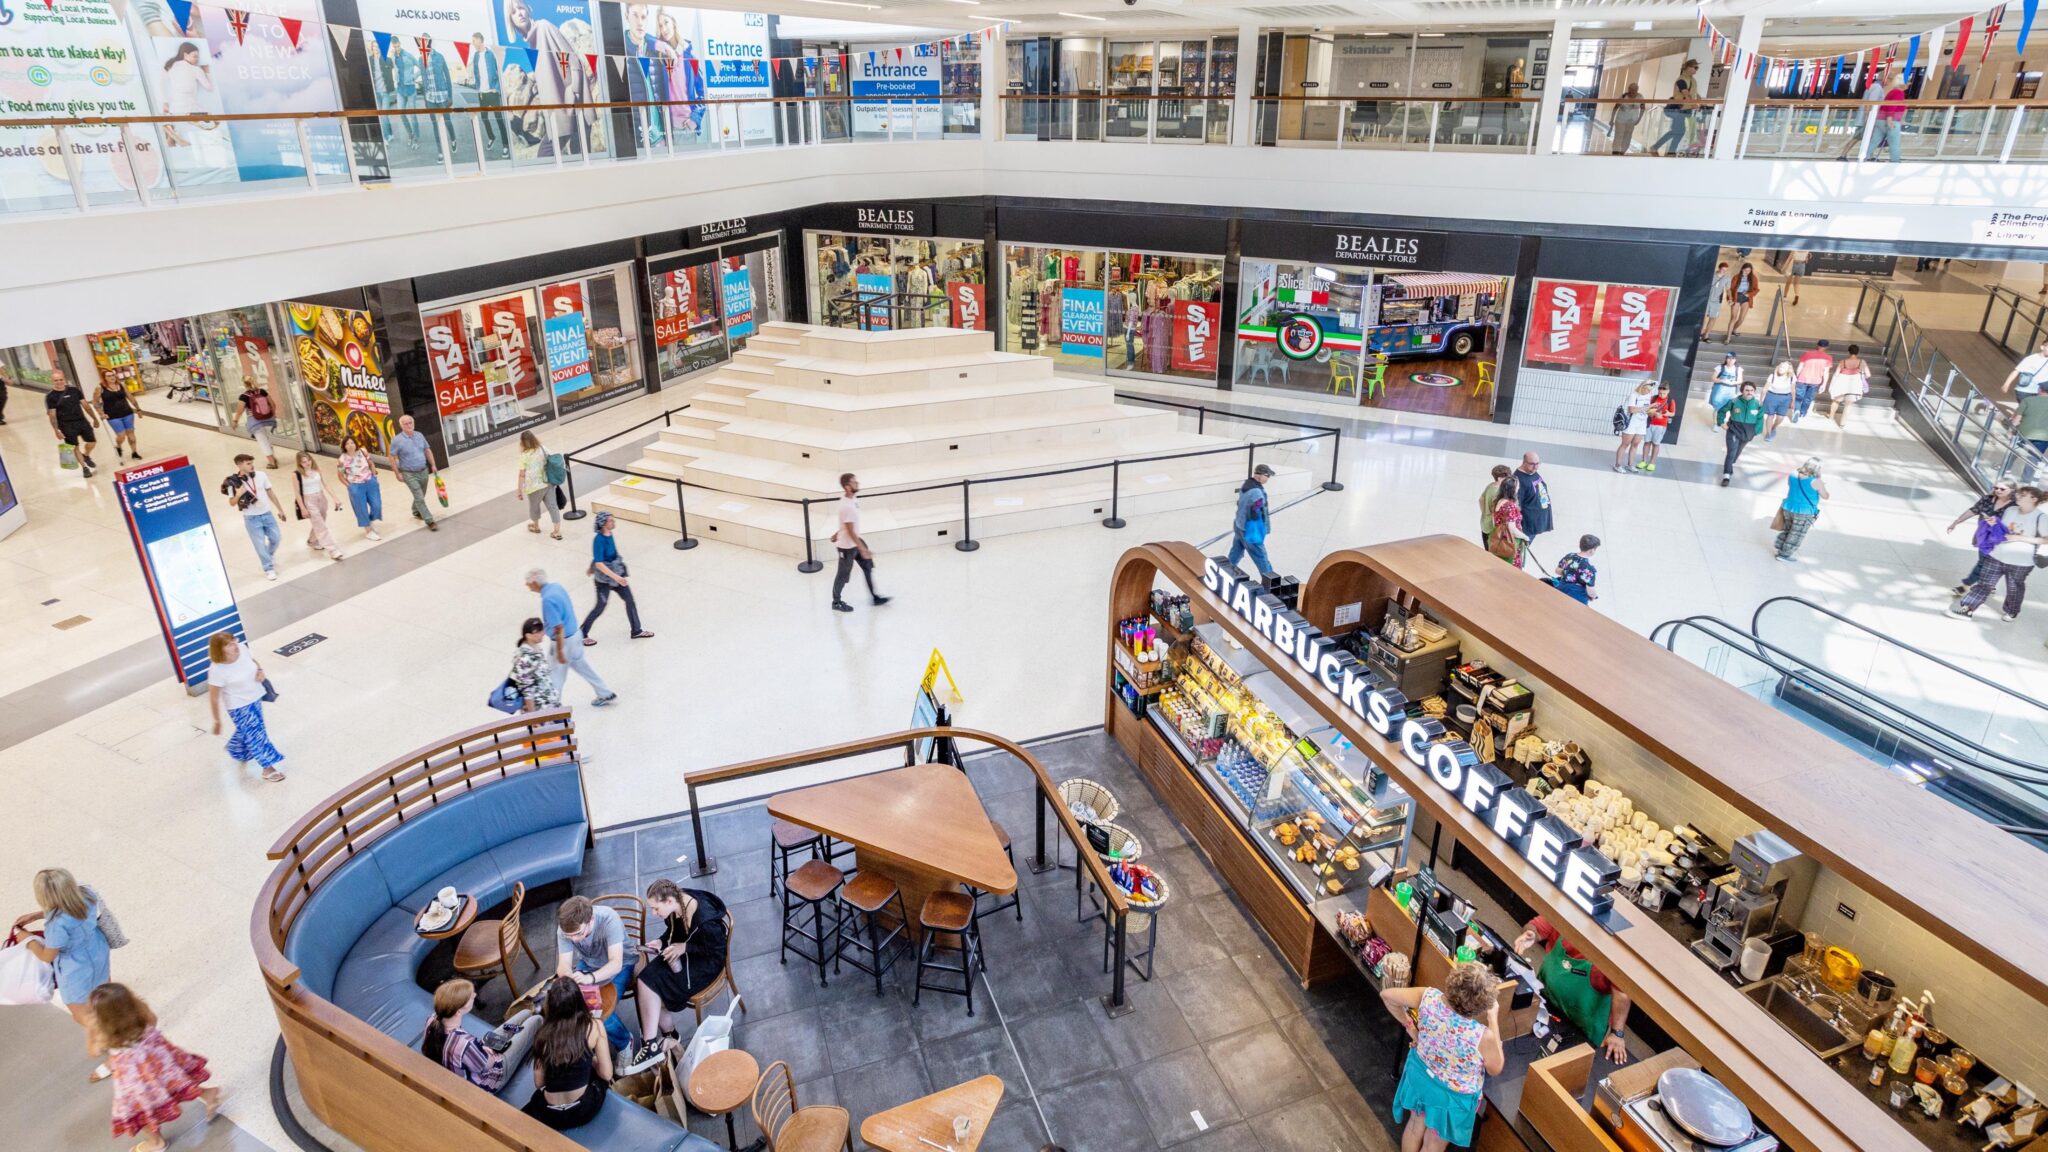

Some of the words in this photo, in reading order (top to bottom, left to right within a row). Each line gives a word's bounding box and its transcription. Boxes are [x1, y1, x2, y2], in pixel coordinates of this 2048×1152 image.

[556, 5, 584, 14] APRICOT
[11, 46, 24, 58] to
[27, 46, 44, 58] eat
[47, 46, 66, 59] the
[67, 45, 100, 59] Naked
[101, 46, 127, 63] Way!
[249, 44, 291, 59] NEW
[707, 39, 763, 57] Entrance
[238, 65, 312, 80] BEDECK
[864, 63, 928, 77] Entrance
[876, 82, 916, 90] Pre-booked
[35, 102, 65, 112] menu
[68, 99, 95, 115] gives
[98, 101, 117, 114] you
[119, 99, 136, 111] the
[71, 142, 93, 154] the
[857, 208, 914, 224] BEALES
[1755, 209, 1779, 217] Skills
[1789, 211, 1829, 220] Learning
[2002, 213, 2021, 221] The
[858, 222, 892, 230] DEPARTMENT
[894, 223, 914, 231] STORES
[1753, 219, 1775, 227] NHS
[701, 230, 731, 242] DEPARTMENT
[731, 227, 747, 236] STORES
[1336, 234, 1419, 255] BEALES
[1335, 250, 1386, 261] DEPARTMENT
[1387, 254, 1417, 264] STORES
[1062, 298, 1103, 314] FINAL
[741, 312, 751, 322] ON
[1062, 311, 1104, 322] CLEARANCE
[1550, 286, 1581, 353] SALE
[656, 318, 687, 340] SALE
[1062, 319, 1103, 333] EVENT
[1186, 303, 1210, 362] SALE
[1619, 291, 1651, 360] SALE
[545, 325, 585, 346] FINAL
[1063, 333, 1085, 344] NOW
[1087, 335, 1103, 345] ON
[575, 362, 589, 374] ON
[673, 364, 692, 377] Beales
[700, 357, 717, 367] Poole
[439, 380, 486, 407] SALE
[456, 443, 469, 451] Shop
[126, 466, 165, 482] DOLPHIN
[1203, 557, 1391, 735] STARBUCKS
[1401, 719, 1602, 916] COFFEE
